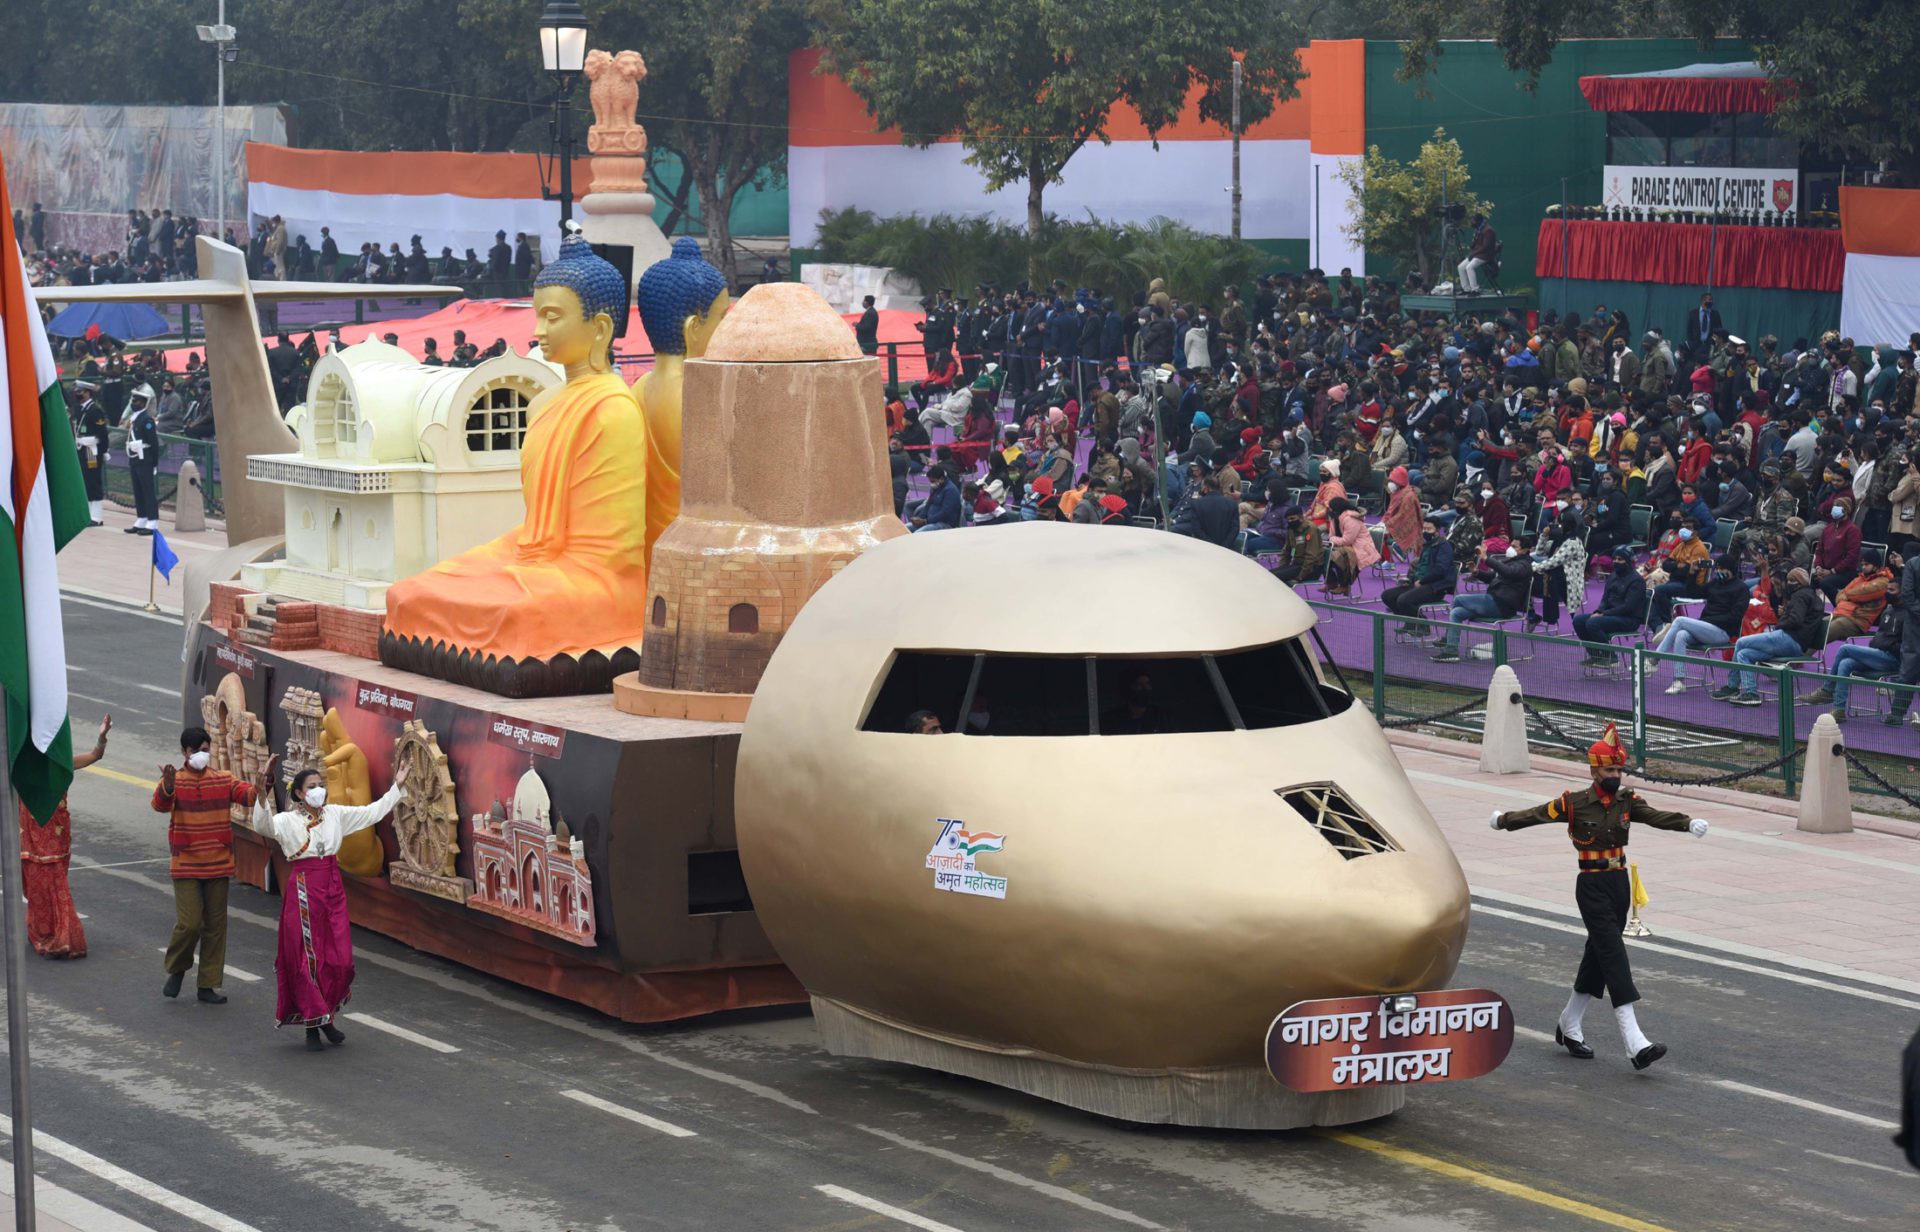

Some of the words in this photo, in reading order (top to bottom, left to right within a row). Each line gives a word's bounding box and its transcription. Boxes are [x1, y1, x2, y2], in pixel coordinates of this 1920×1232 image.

[1632, 176, 1670, 206] PARADE
[1723, 179, 1765, 209] CENTRE
[936, 872, 962, 892] अमृत
[964, 871, 1006, 892] महोत्सव
[963, 862, 974, 871] का
[1282, 1011, 1372, 1046] नागर
[1377, 997, 1503, 1040] विमानन
[1331, 1044, 1452, 1085] मंत्रालय
